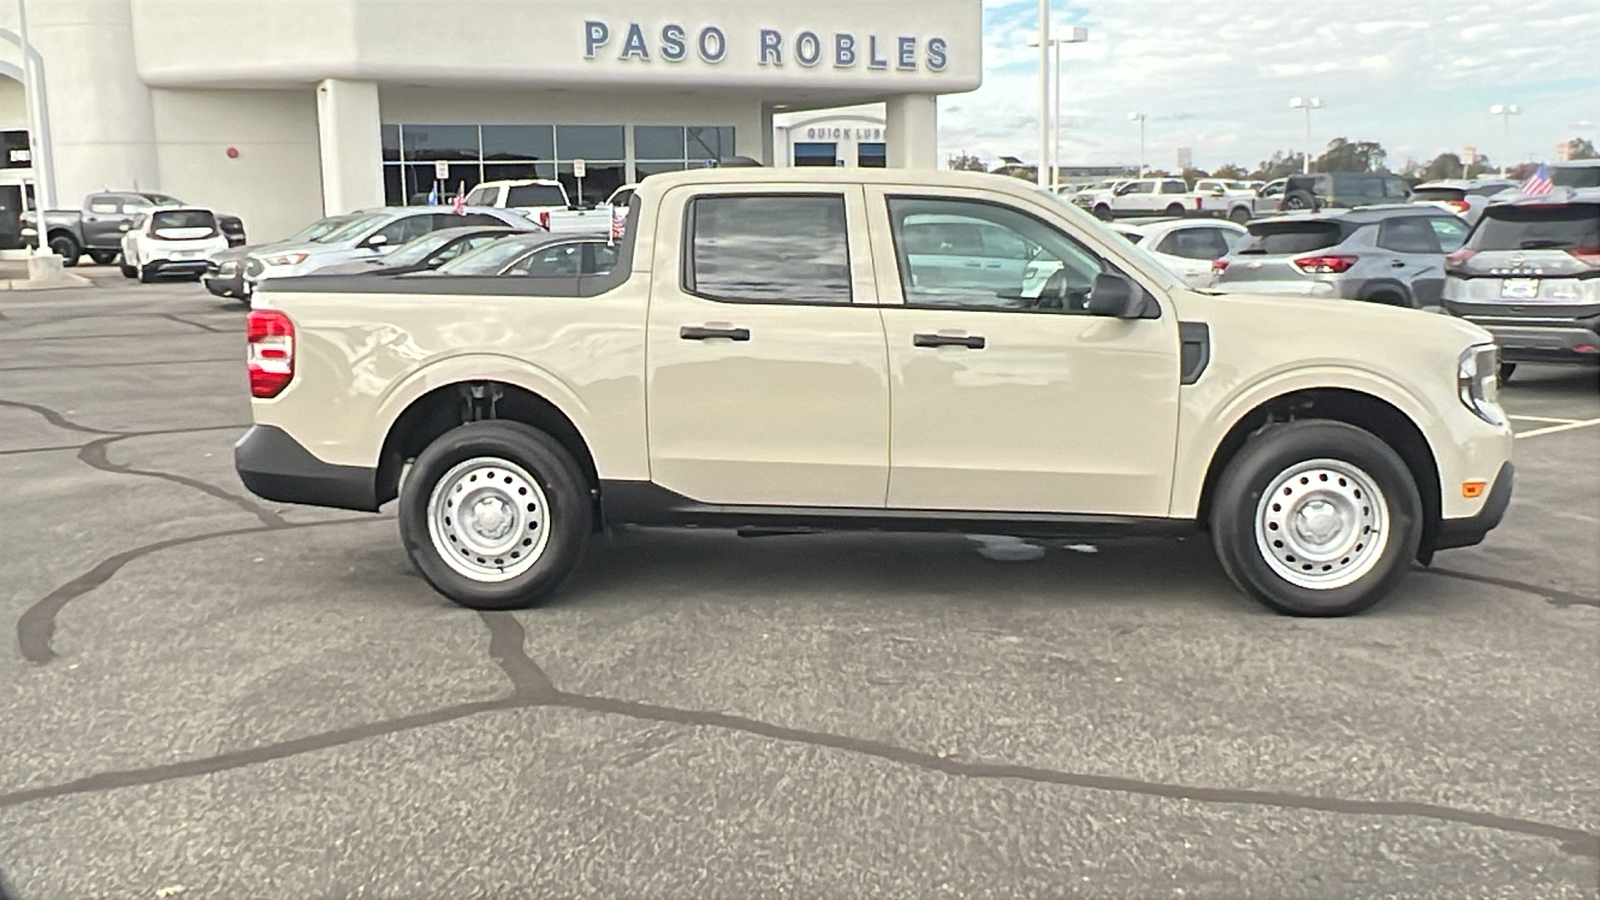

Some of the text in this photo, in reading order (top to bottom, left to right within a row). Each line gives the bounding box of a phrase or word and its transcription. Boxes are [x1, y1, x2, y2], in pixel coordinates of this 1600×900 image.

[583, 20, 948, 71] PASO ROBLES
[807, 127, 850, 139] QUICK
